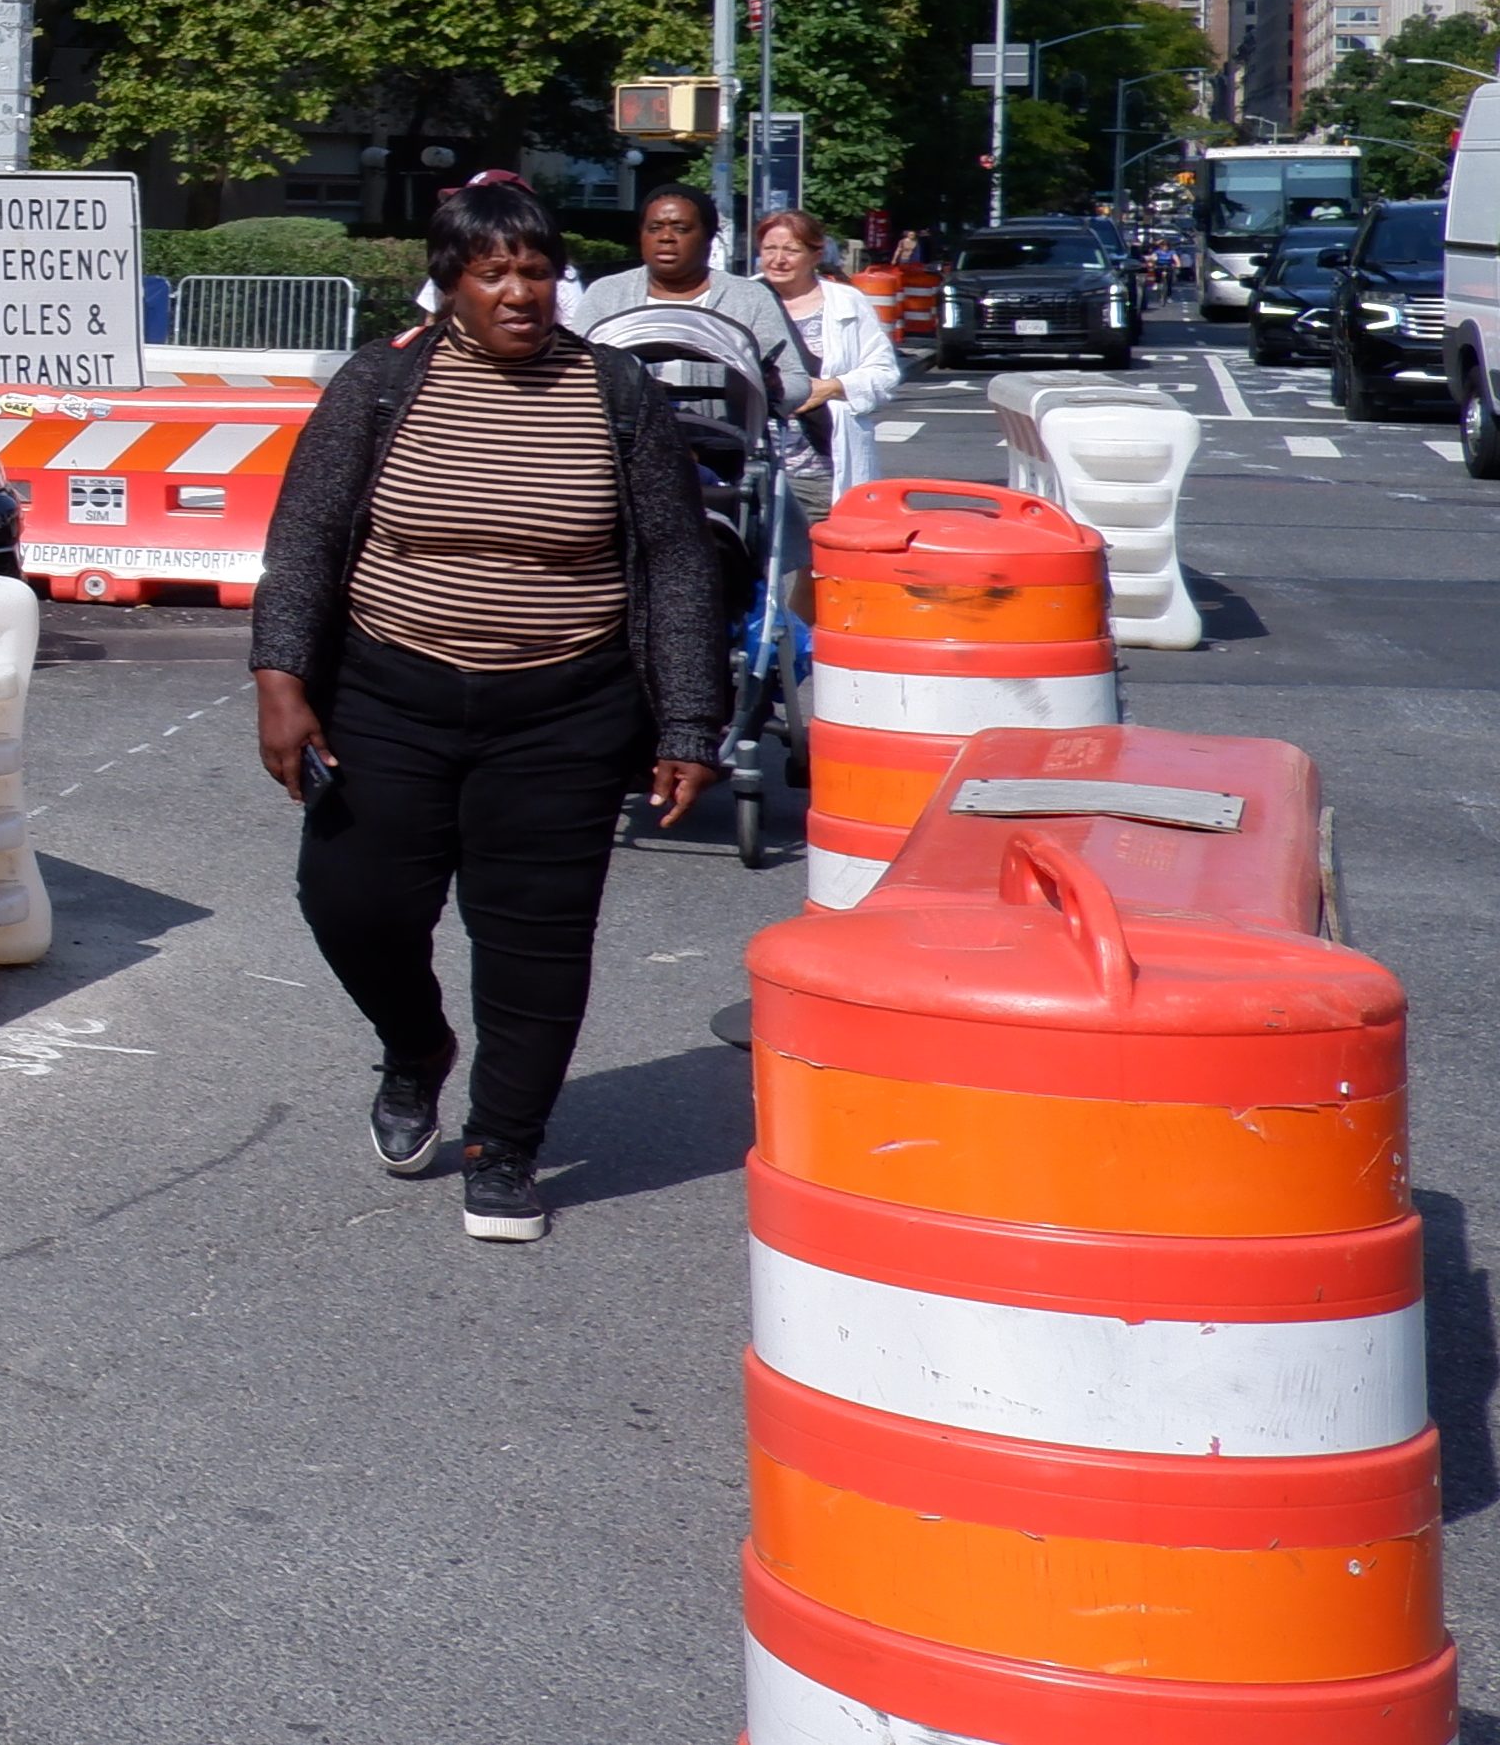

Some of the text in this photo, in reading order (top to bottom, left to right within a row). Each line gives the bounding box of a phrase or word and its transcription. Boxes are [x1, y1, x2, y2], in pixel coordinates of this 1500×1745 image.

[87, 305, 107, 335] &
[0, 354, 115, 385] TRANSIT
[85, 510, 109, 521] SIM
[33, 545, 257, 568] DEPARTMENT OF TRANSPORTA
